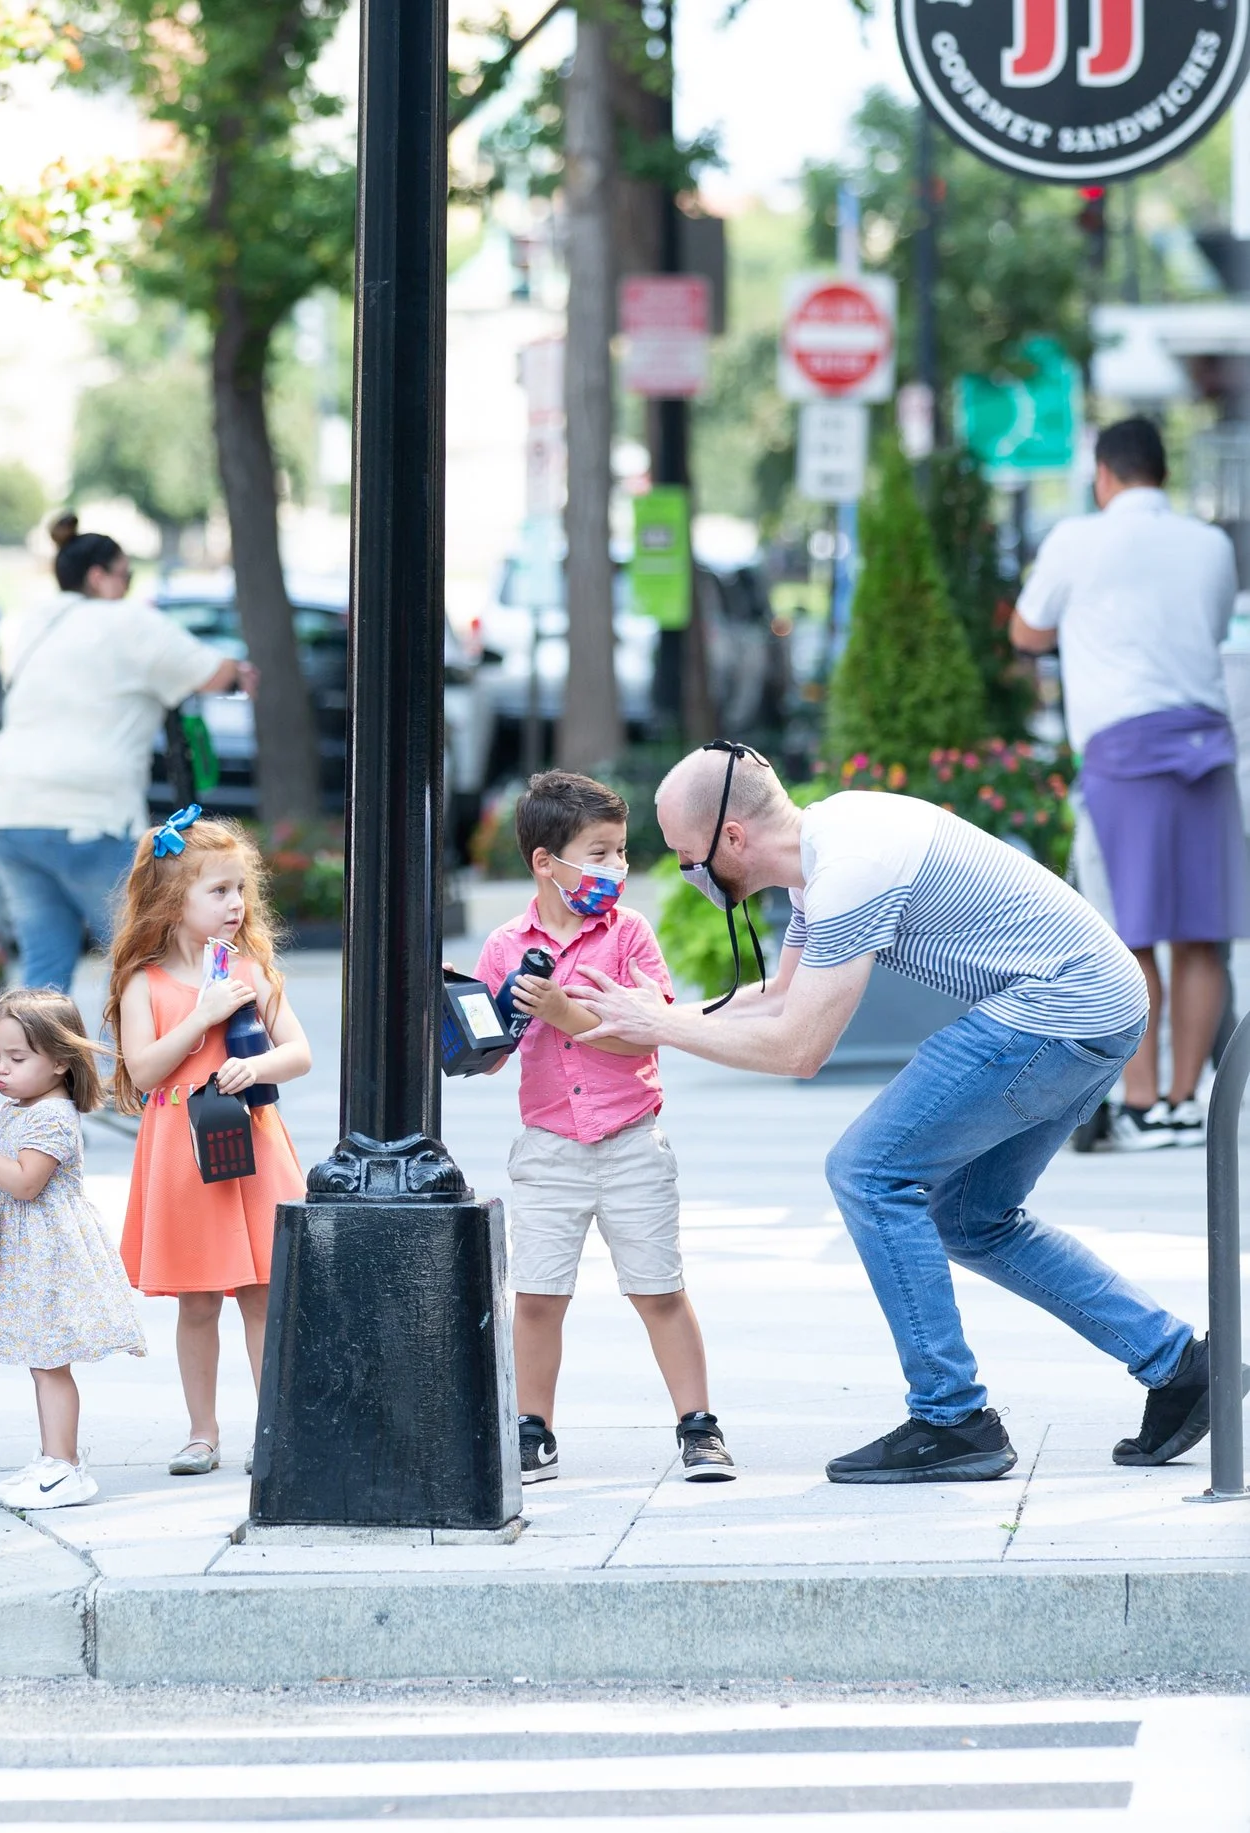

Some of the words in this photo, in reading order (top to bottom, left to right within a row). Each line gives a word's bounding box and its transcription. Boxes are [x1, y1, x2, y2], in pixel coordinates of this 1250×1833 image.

[931, 30, 1053, 148] GOURMET
[1057, 28, 1221, 153] SANDWICHES
[509, 1020, 528, 1038] ki
